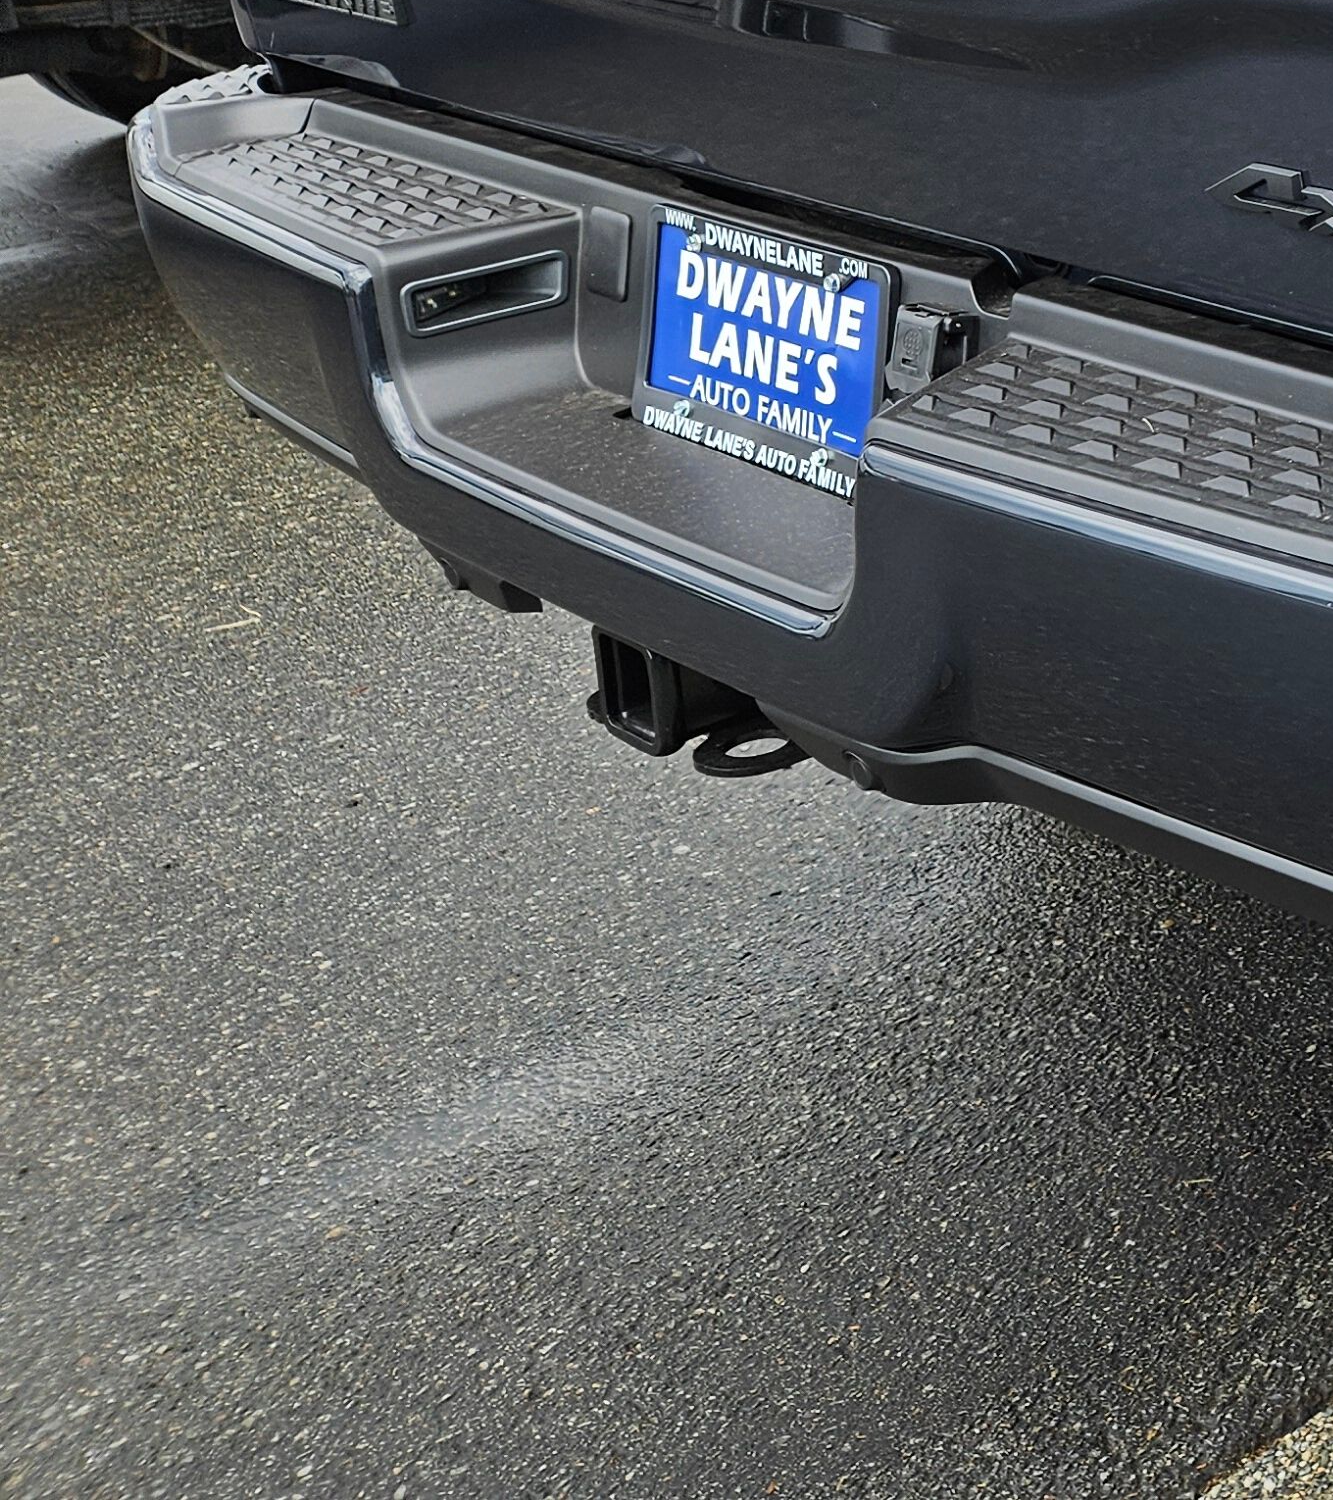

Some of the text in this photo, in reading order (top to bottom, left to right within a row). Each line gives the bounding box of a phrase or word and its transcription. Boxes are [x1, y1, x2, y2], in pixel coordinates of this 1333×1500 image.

[705, 222, 823, 277] DWAYNELANE
[838, 257, 868, 279] .COM
[676, 249, 865, 351] DWAYNE
[689, 312, 838, 405] LANE'S
[643, 406, 856, 498] DWAYNE LANE'S AUTO FAMILY
[689, 374, 833, 444] AUTO FAMILY
